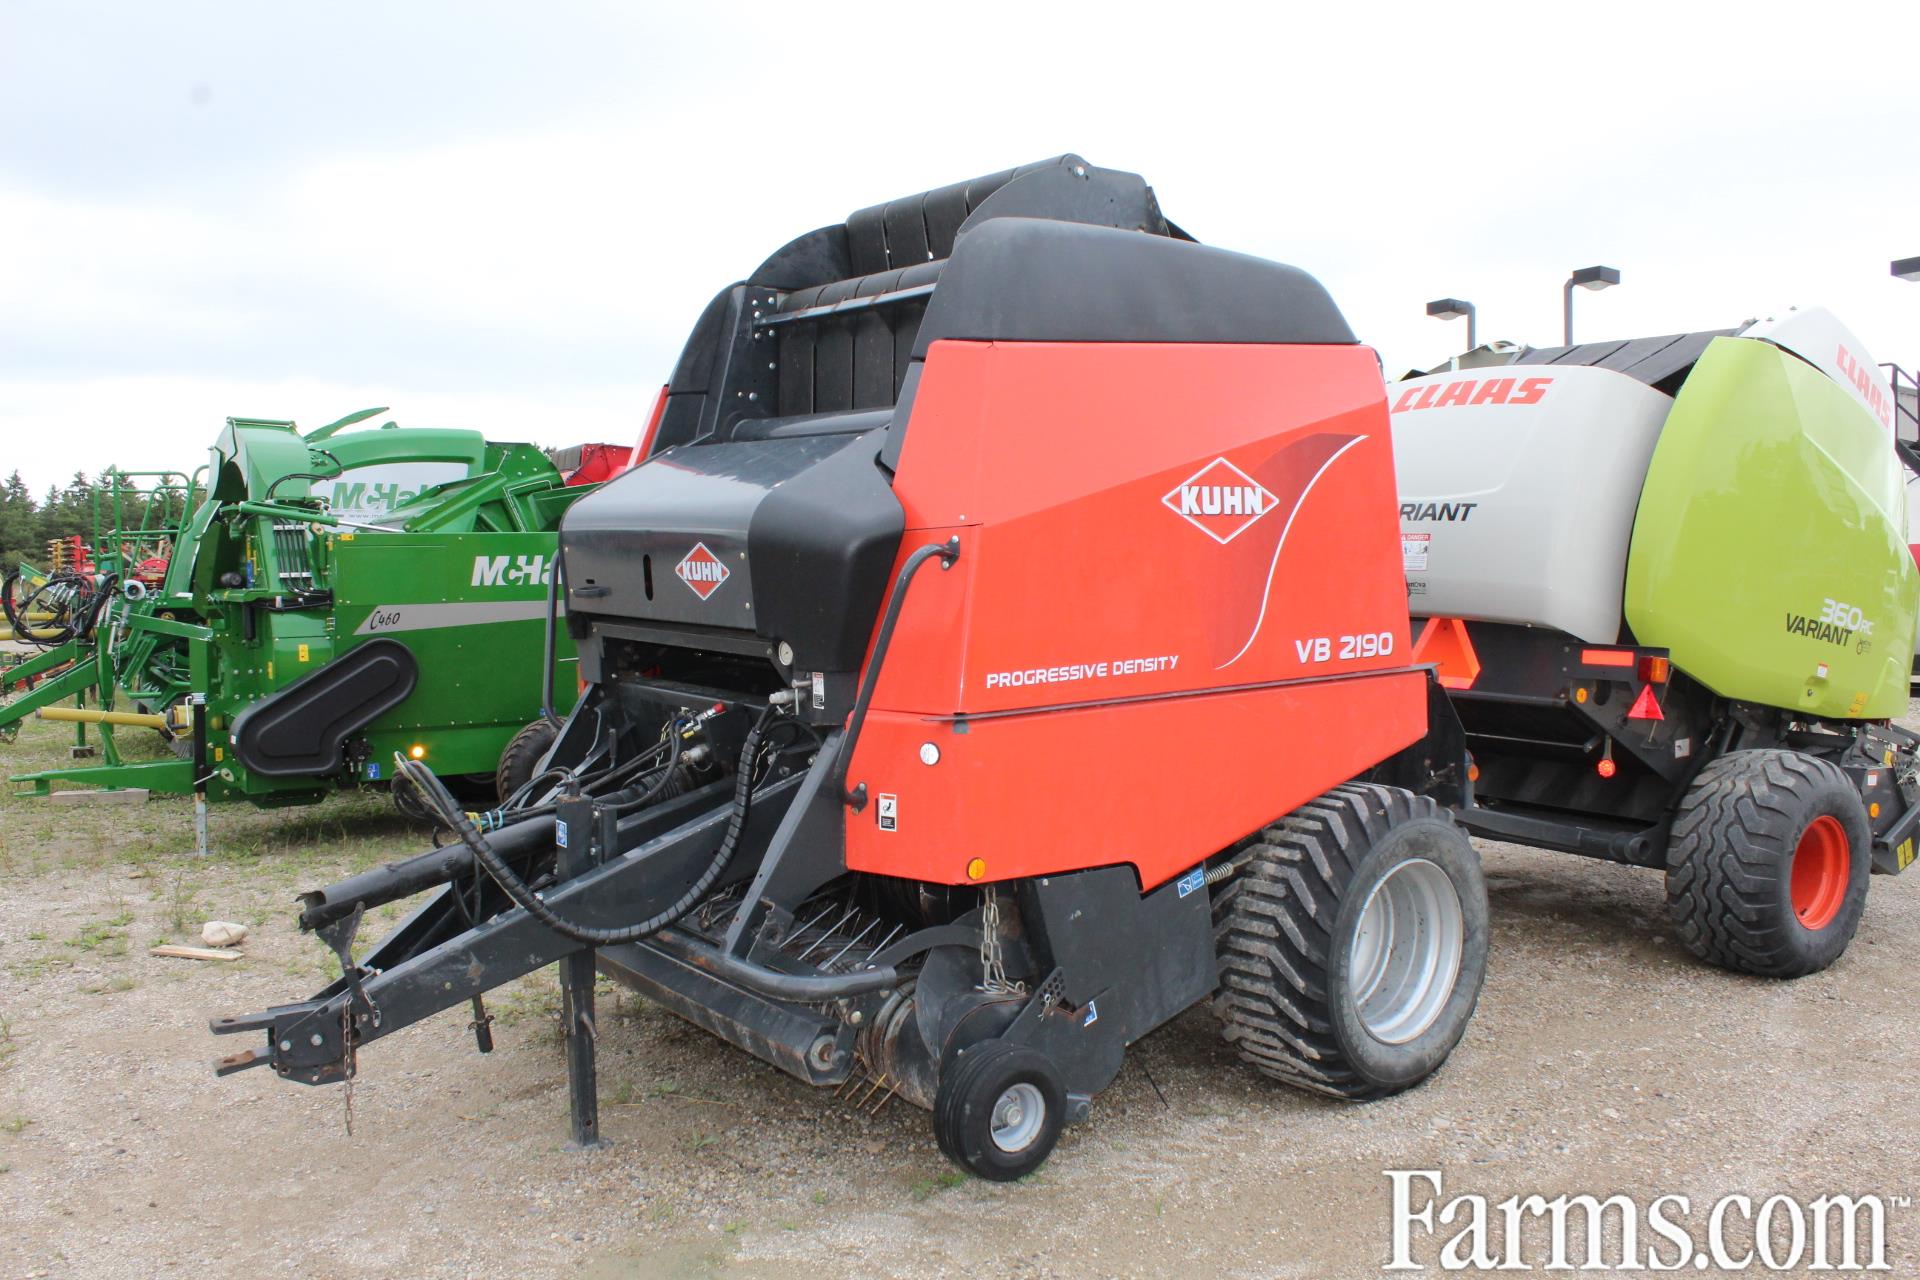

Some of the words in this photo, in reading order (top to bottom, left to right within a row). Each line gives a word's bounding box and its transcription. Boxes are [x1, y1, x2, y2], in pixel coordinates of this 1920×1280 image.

[1391, 378, 1554, 413] CLAAS
[1836, 343, 1891, 429] CLAAS
[331, 482, 430, 510] McHa
[1181, 485, 1264, 515] KUHN
[682, 561, 723, 582] KUHN
[369, 610, 401, 631] C460
[1786, 612, 1853, 647] VARIANT
[1295, 637, 1332, 664] VB
[1338, 632, 1394, 660] 2190
[986, 662, 1108, 689] PROGRESSIVE
[1112, 655, 1179, 676] DENSITY
